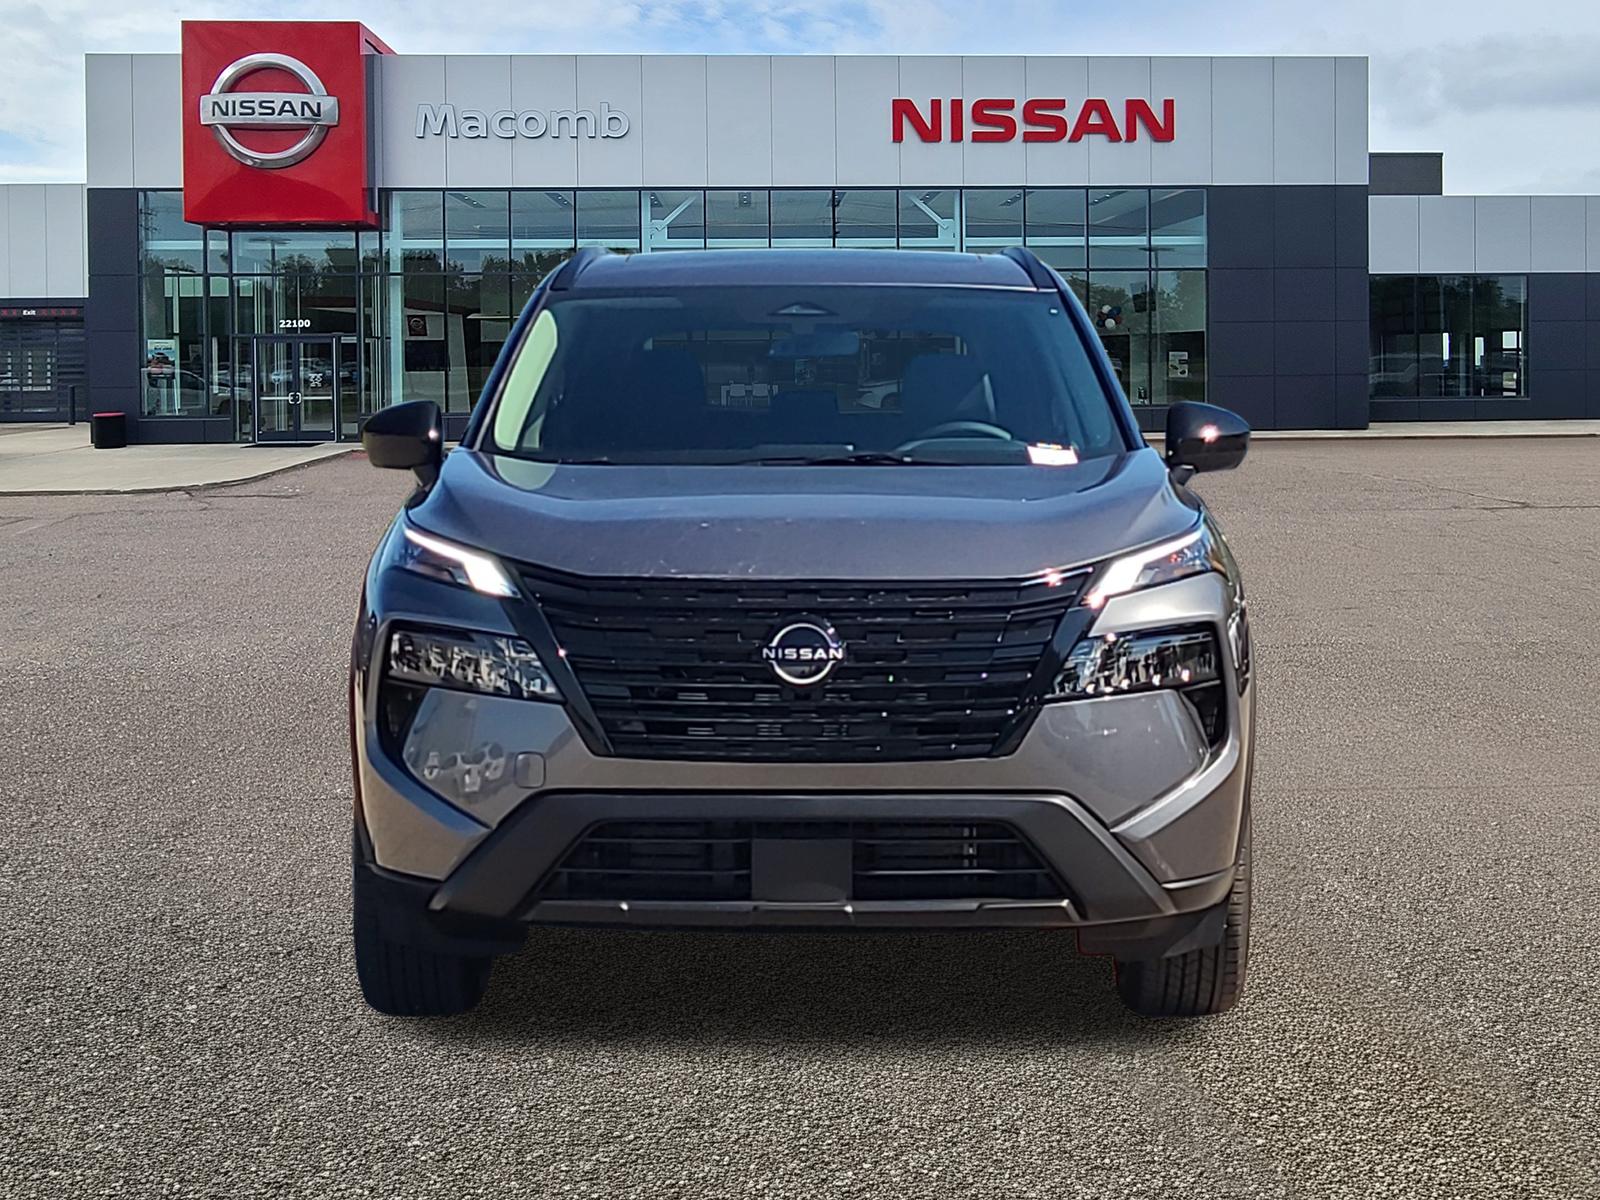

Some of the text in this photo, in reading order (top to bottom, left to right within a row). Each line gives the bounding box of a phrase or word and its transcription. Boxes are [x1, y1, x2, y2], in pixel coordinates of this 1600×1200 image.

[212, 100, 322, 118] NISSAN
[415, 101, 631, 139] Macomb
[891, 98, 1175, 143] NISSAN
[279, 319, 311, 328] 22100
[762, 647, 844, 660] NISSAN
